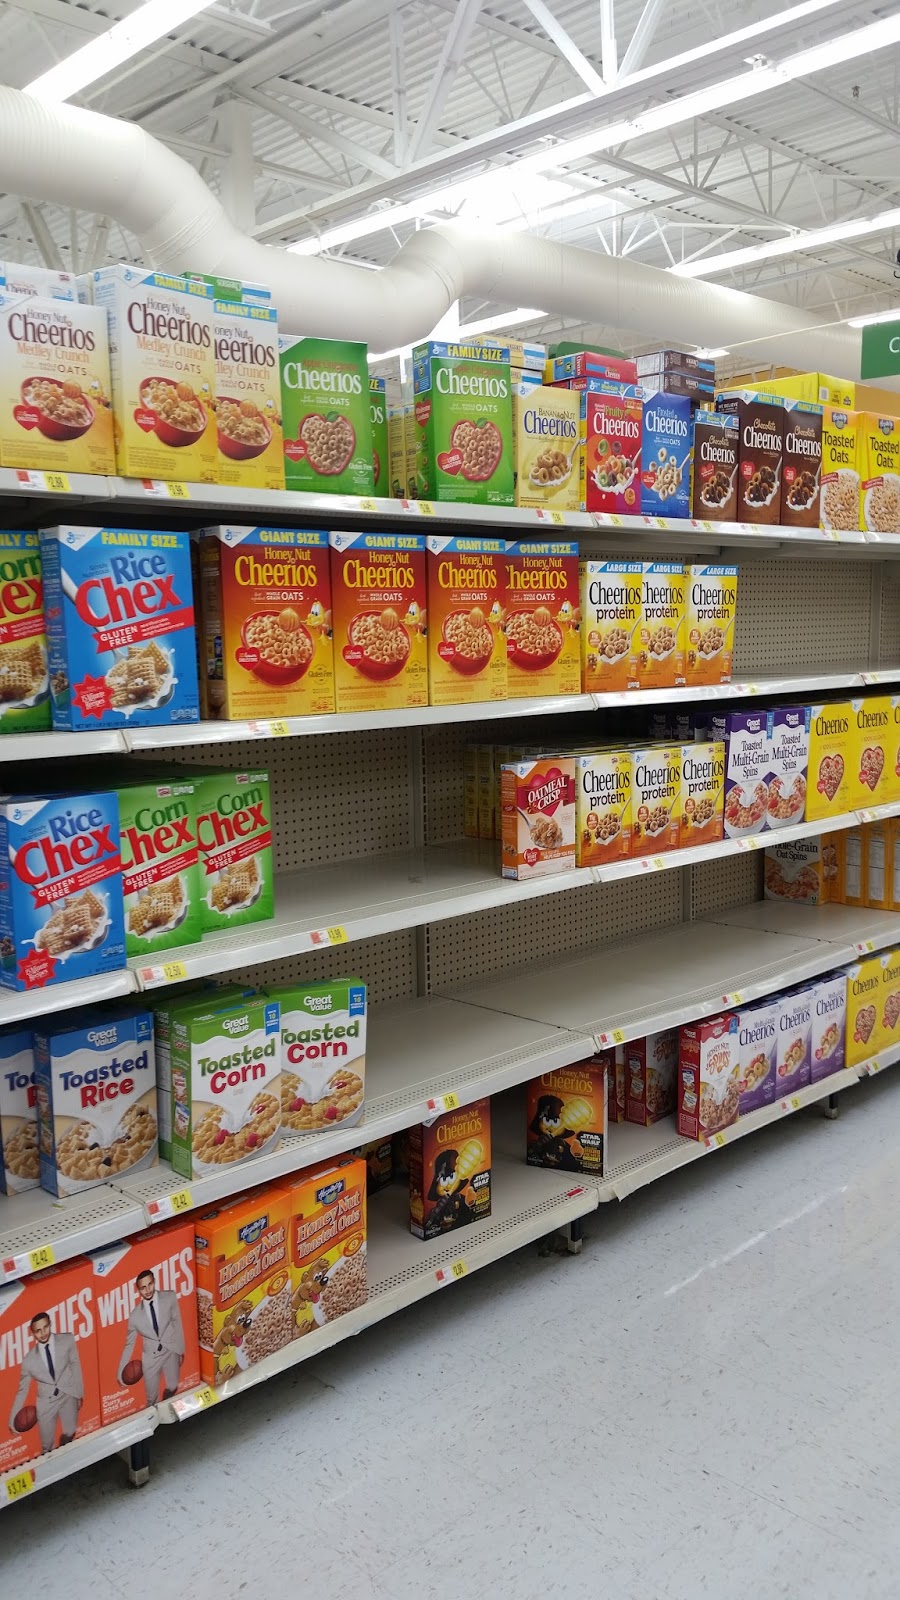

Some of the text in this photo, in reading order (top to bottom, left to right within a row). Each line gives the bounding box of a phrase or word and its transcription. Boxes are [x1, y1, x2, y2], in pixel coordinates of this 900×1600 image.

[52, 311, 68, 324] Nut
[216, 303, 270, 320] FAMILY SIZE
[8, 312, 96, 351] Cheerios
[128, 301, 211, 348] Cheerios
[214, 326, 249, 340] oney Nut
[448, 345, 482, 359] FAMILY
[483, 347, 502, 361] SIZE
[57, 364, 88, 376] OATS
[175, 361, 202, 375] OATS
[238, 380, 265, 392] OATS
[283, 362, 362, 394] Cheerios
[435, 367, 508, 398] Cheerios
[329, 397, 350, 407] OATS
[475, 403, 498, 413] OATS
[605, 406, 624, 418] Fruity
[657, 407, 674, 418] Frosted
[524, 410, 577, 438] Cheerios
[593, 412, 639, 438] Cheerios
[645, 410, 688, 437] Cheerios
[754, 419, 776, 431] Chocolate
[794, 426, 815, 437] Chocolate
[709, 436, 729, 447] Chocolate
[743, 427, 782, 451] Cheerios
[786, 432, 821, 457] Cheerios
[822, 430, 854, 448] Toasted
[870, 436, 900, 454] Toasted
[700, 442, 735, 464] Cheerios
[830, 448, 849, 464] Oats
[876, 454, 894, 468] Oats
[102, 532, 178, 548] FAMILY SIZE
[259, 531, 320, 545] GIANT SIZE
[365, 535, 418, 549] GIANT SIZE
[456, 539, 499, 551] GIANT SIZE
[264, 547, 311, 563] Honey Nut
[519, 543, 570, 554] GIANT SIZE
[369, 551, 409, 566] Honey Nut
[460, 554, 493, 568] Honey Nut
[523, 557, 563, 570] Honey Nut
[0, 556, 41, 582] orn
[110, 551, 166, 585] Rice
[234, 556, 318, 588] Cheerios
[343, 560, 415, 588] Cheerios
[438, 562, 497, 589] Cheerios
[606, 563, 642, 573] LARGE SIZE
[653, 563, 683, 573] LARGE SIZE
[707, 567, 736, 575] LARGE SIZE
[75, 574, 182, 627] Chex
[281, 592, 304, 601] OATS
[383, 593, 403, 601] OATS
[471, 593, 488, 601] OATS
[536, 593, 556, 601] OATS
[589, 581, 641, 605] Cheerios
[692, 584, 735, 605] Cheerios
[596, 607, 635, 623] protein
[645, 606, 678, 622] protein
[697, 608, 730, 620] protein
[100, 625, 138, 642] GLUTEN
[109, 635, 134, 648] FREE
[746, 718, 761, 727] Great
[816, 716, 849, 737] Cheerios
[857, 710, 888, 729] Cheerios
[741, 739, 763, 752] Toasted
[781, 732, 801, 745] Toasted
[772, 745, 807, 759] Multi-Grain
[683, 754, 723, 781] Cheerios
[742, 767, 758, 778] Spins
[782, 759, 797, 770] Spins
[583, 766, 630, 793] Cheerios
[636, 762, 680, 788] Cheerios
[528, 776, 567, 803] OATMEAL
[688, 777, 719, 796] protein
[217, 788, 263, 816] Corn
[537, 789, 561, 810] CRISP
[590, 792, 626, 810] protein
[642, 787, 675, 804] protein
[134, 800, 188, 832] Corn
[50, 808, 103, 842] Rice
[197, 802, 269, 852] Chex
[14, 824, 119, 885] Chex
[208, 850, 237, 866] GLUTEN
[776, 850, 807, 861] Oat Spins
[215, 858, 234, 869] FREE
[125, 867, 157, 887] GLUTEN
[133, 877, 154, 890] FREE
[38, 877, 75, 897] GLUTEN
[47, 887, 70, 901] FREE
[303, 995, 332, 1007] Great
[310, 1002, 332, 1011] Value
[816, 993, 844, 1016] Cheerios
[222, 1015, 249, 1030] Great
[780, 1008, 811, 1032] Cheerios
[87, 1027, 117, 1042] Great
[229, 1023, 249, 1034] Value
[739, 1021, 775, 1046] Cheerios
[95, 1035, 117, 1048] Value
[198, 1039, 275, 1077] Toasted
[287, 1041, 348, 1064] Corn
[60, 1051, 148, 1091] Toasted
[210, 1061, 266, 1094] Corn
[80, 1077, 134, 1108] Rice
[452, 1109, 479, 1125] Honey Nut
[436, 1117, 482, 1143] Cheerios
[581, 1133, 601, 1141] STAR
[581, 1138, 601, 1146] WARS
[474, 1172, 489, 1182] STAR
[474, 1178, 490, 1188] WARS
[297, 1190, 360, 1244] Honey Nut
[298, 1209, 360, 1259] Toasted Oats
[32, 1249, 49, 1264] $2.42
[219, 1227, 285, 1287] Honey Nut
[219, 1245, 285, 1303] Toasted Oats
[97, 1247, 194, 1328] WHETIES
[102, 1388, 129, 1401] Stephen
[102, 1399, 121, 1409] Curry
[103, 1398, 135, 1416] 2015 MVP
[11, 1444, 27, 1456] MVP
[7, 1479, 27, 1495] $3.74
